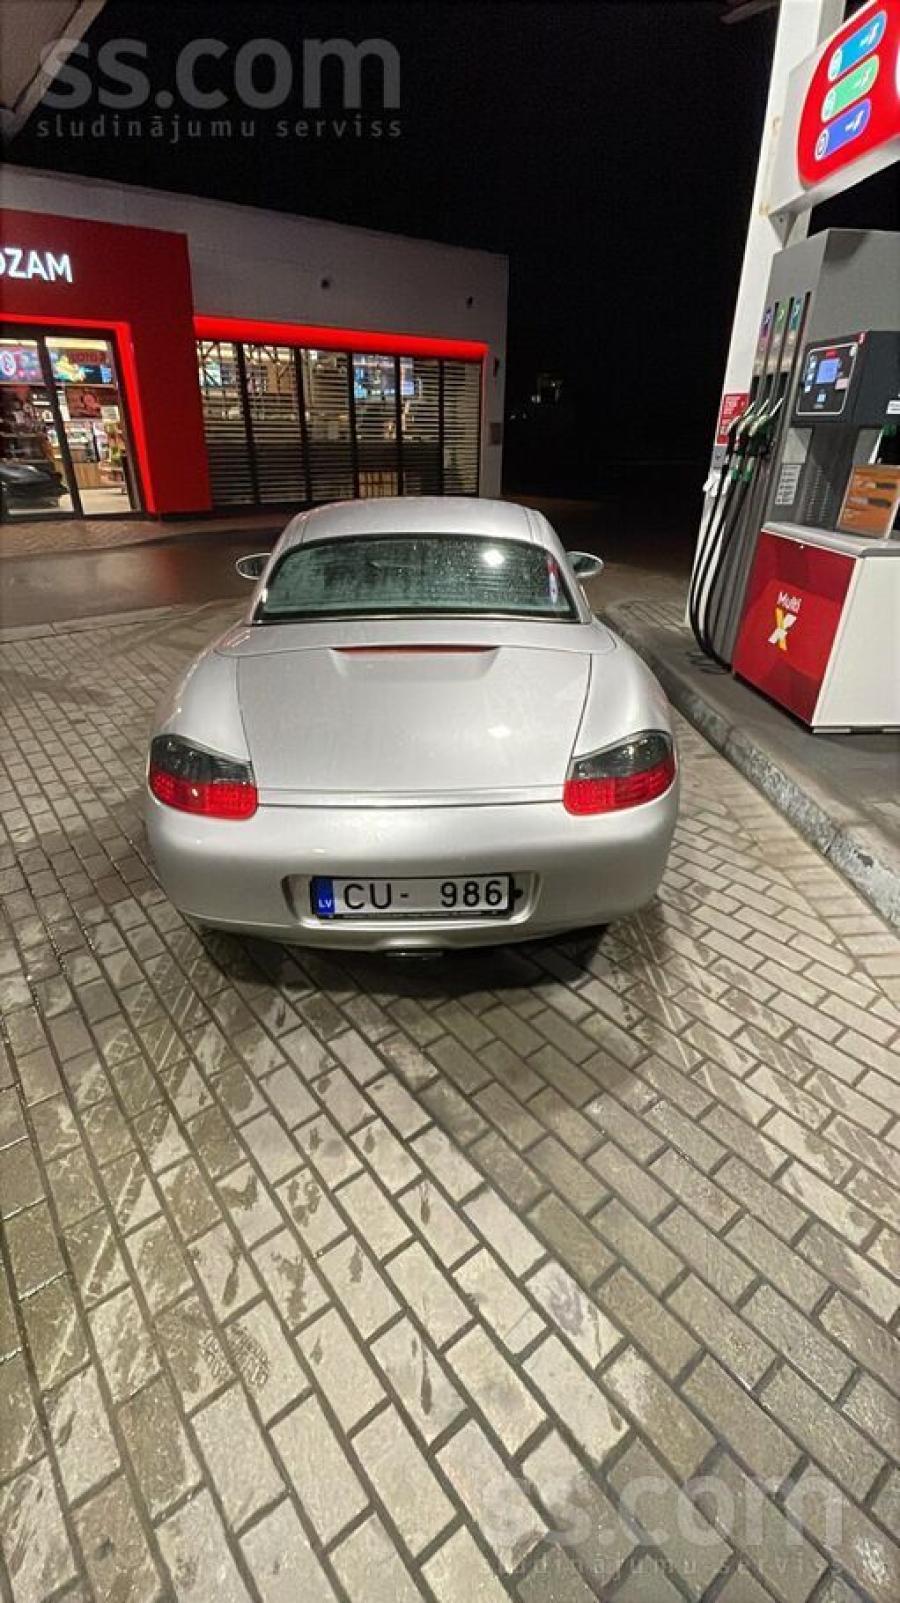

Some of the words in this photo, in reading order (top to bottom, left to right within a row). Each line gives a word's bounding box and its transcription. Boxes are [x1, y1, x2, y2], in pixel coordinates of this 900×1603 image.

[0, 247, 73, 282] ZAM
[318, 898, 332, 908] LV
[440, 881, 503, 908] 986
